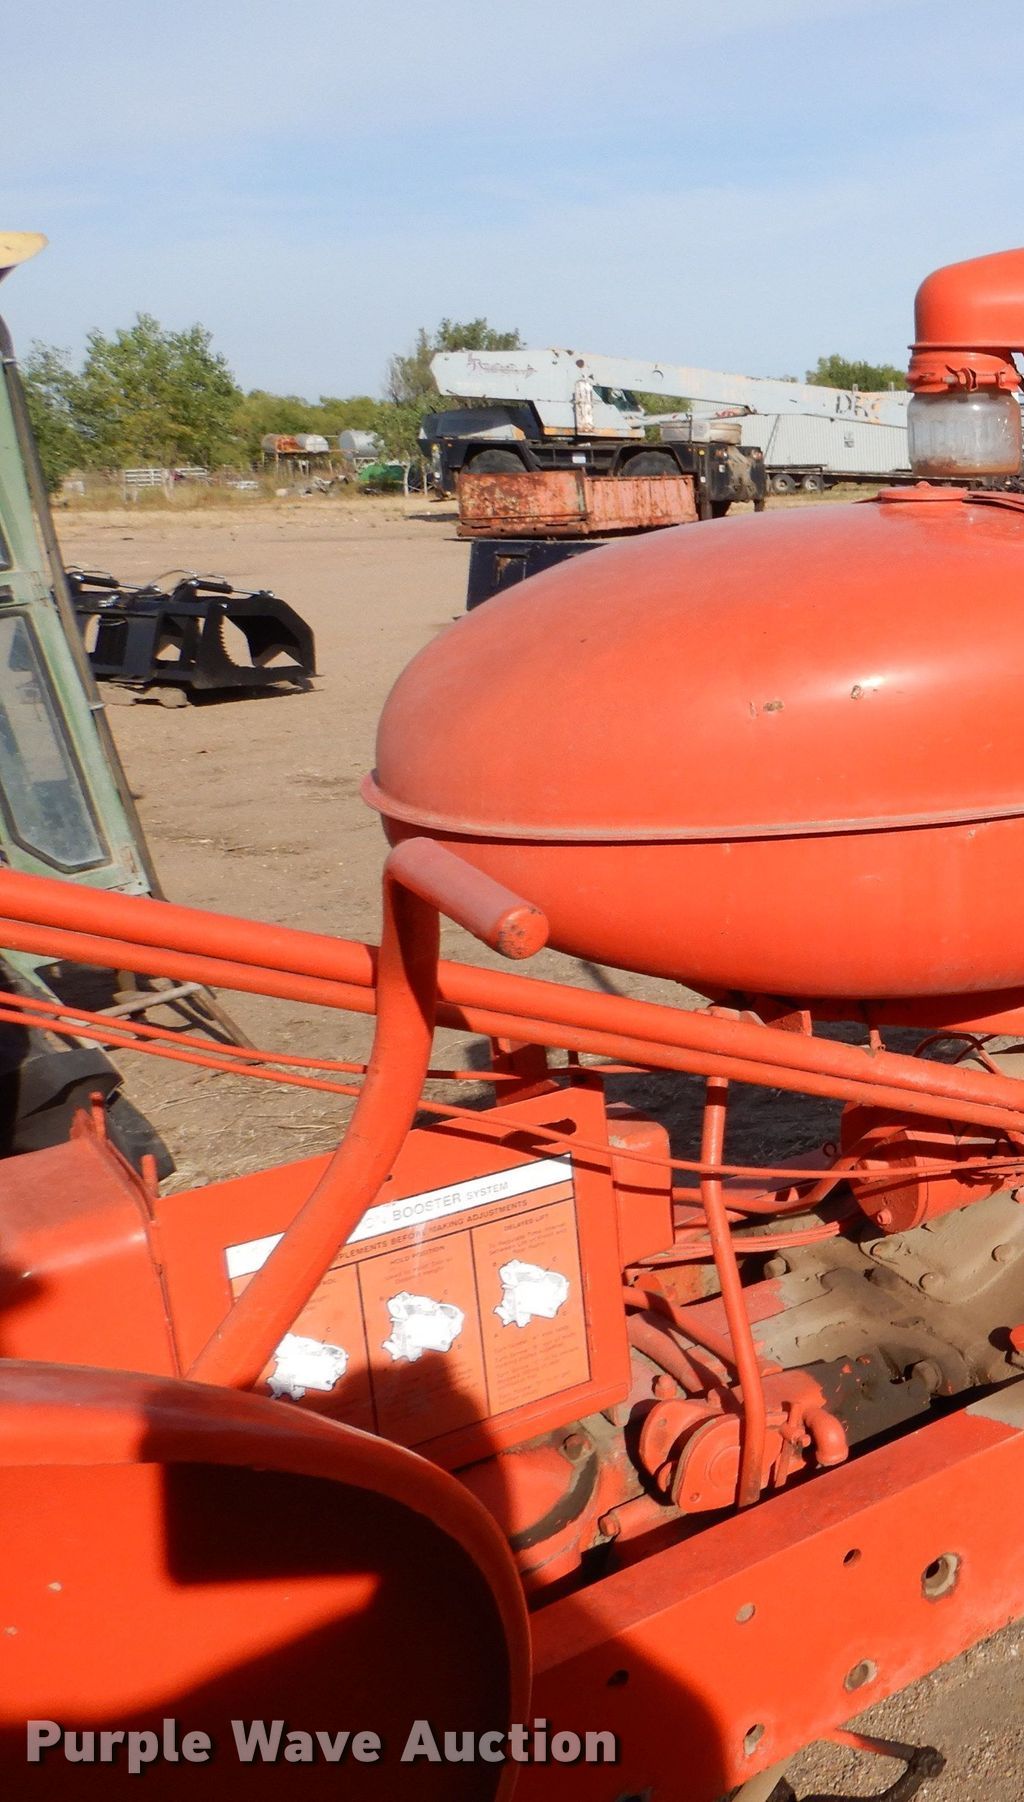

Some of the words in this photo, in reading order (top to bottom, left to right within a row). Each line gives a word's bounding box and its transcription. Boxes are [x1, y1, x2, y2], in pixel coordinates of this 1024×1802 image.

[392, 1192, 462, 1222] BOOSTER
[466, 1181, 509, 1200] SYSTEM
[466, 1200, 529, 1223] ADJUSTMENTS
